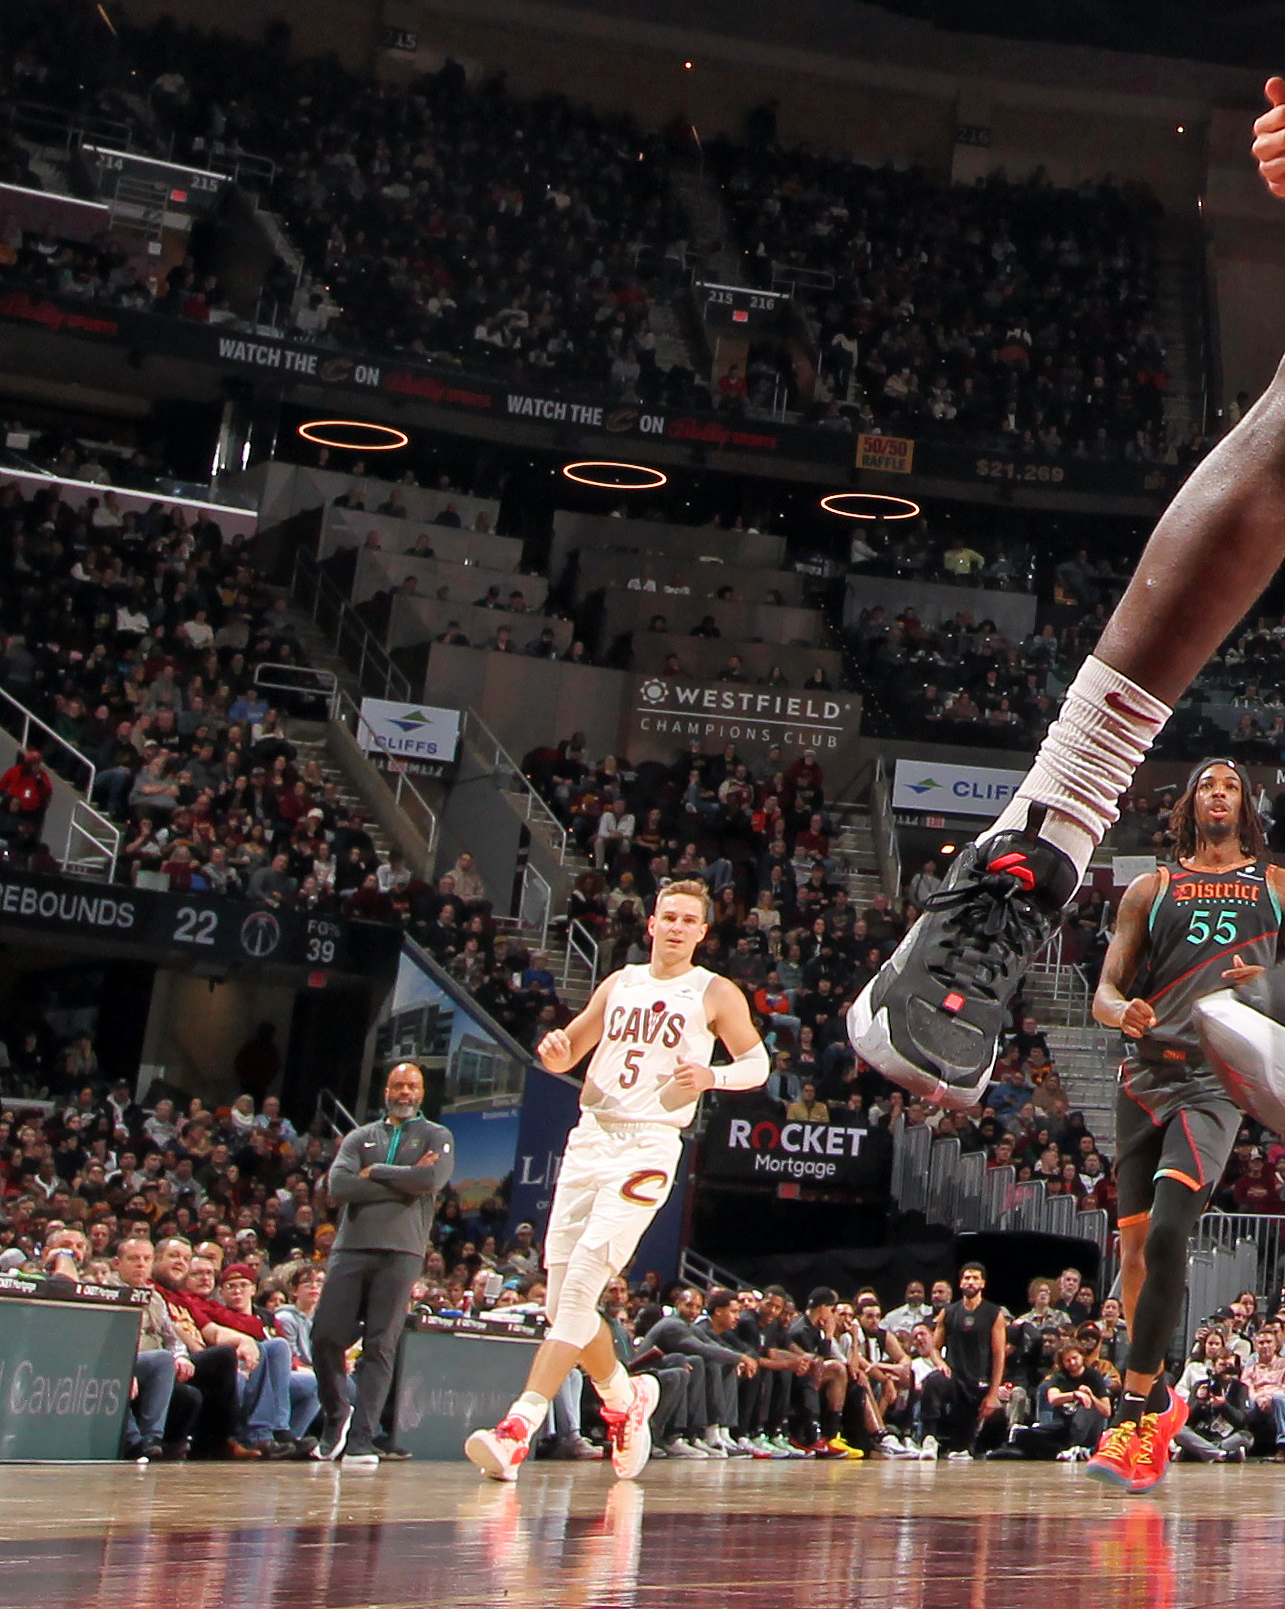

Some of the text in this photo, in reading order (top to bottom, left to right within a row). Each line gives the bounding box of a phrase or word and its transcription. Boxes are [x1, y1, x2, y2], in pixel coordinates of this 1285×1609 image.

[219, 337, 380, 387] WATCH THE ON
[507, 394, 566, 420] WATCH
[571, 404, 604, 426] THE
[639, 415, 664, 434] ON
[675, 686, 840, 720] WESTFIELD
[375, 735, 437, 754] CLIFFS
[640, 718, 837, 749] CHAMPIONS CLUB
[1175, 880, 1259, 902] District
[172, 907, 218, 946] 22
[307, 920, 341, 937] FG%
[1186, 910, 1238, 945] 55
[306, 939, 335, 963] 39
[608, 1006, 685, 1048] CAVS
[620, 1050, 645, 1089] 5
[728, 1119, 868, 1157] ROCKET
[755, 1154, 836, 1179] Mortgage
[9, 1359, 121, 1416] Cavaliers
